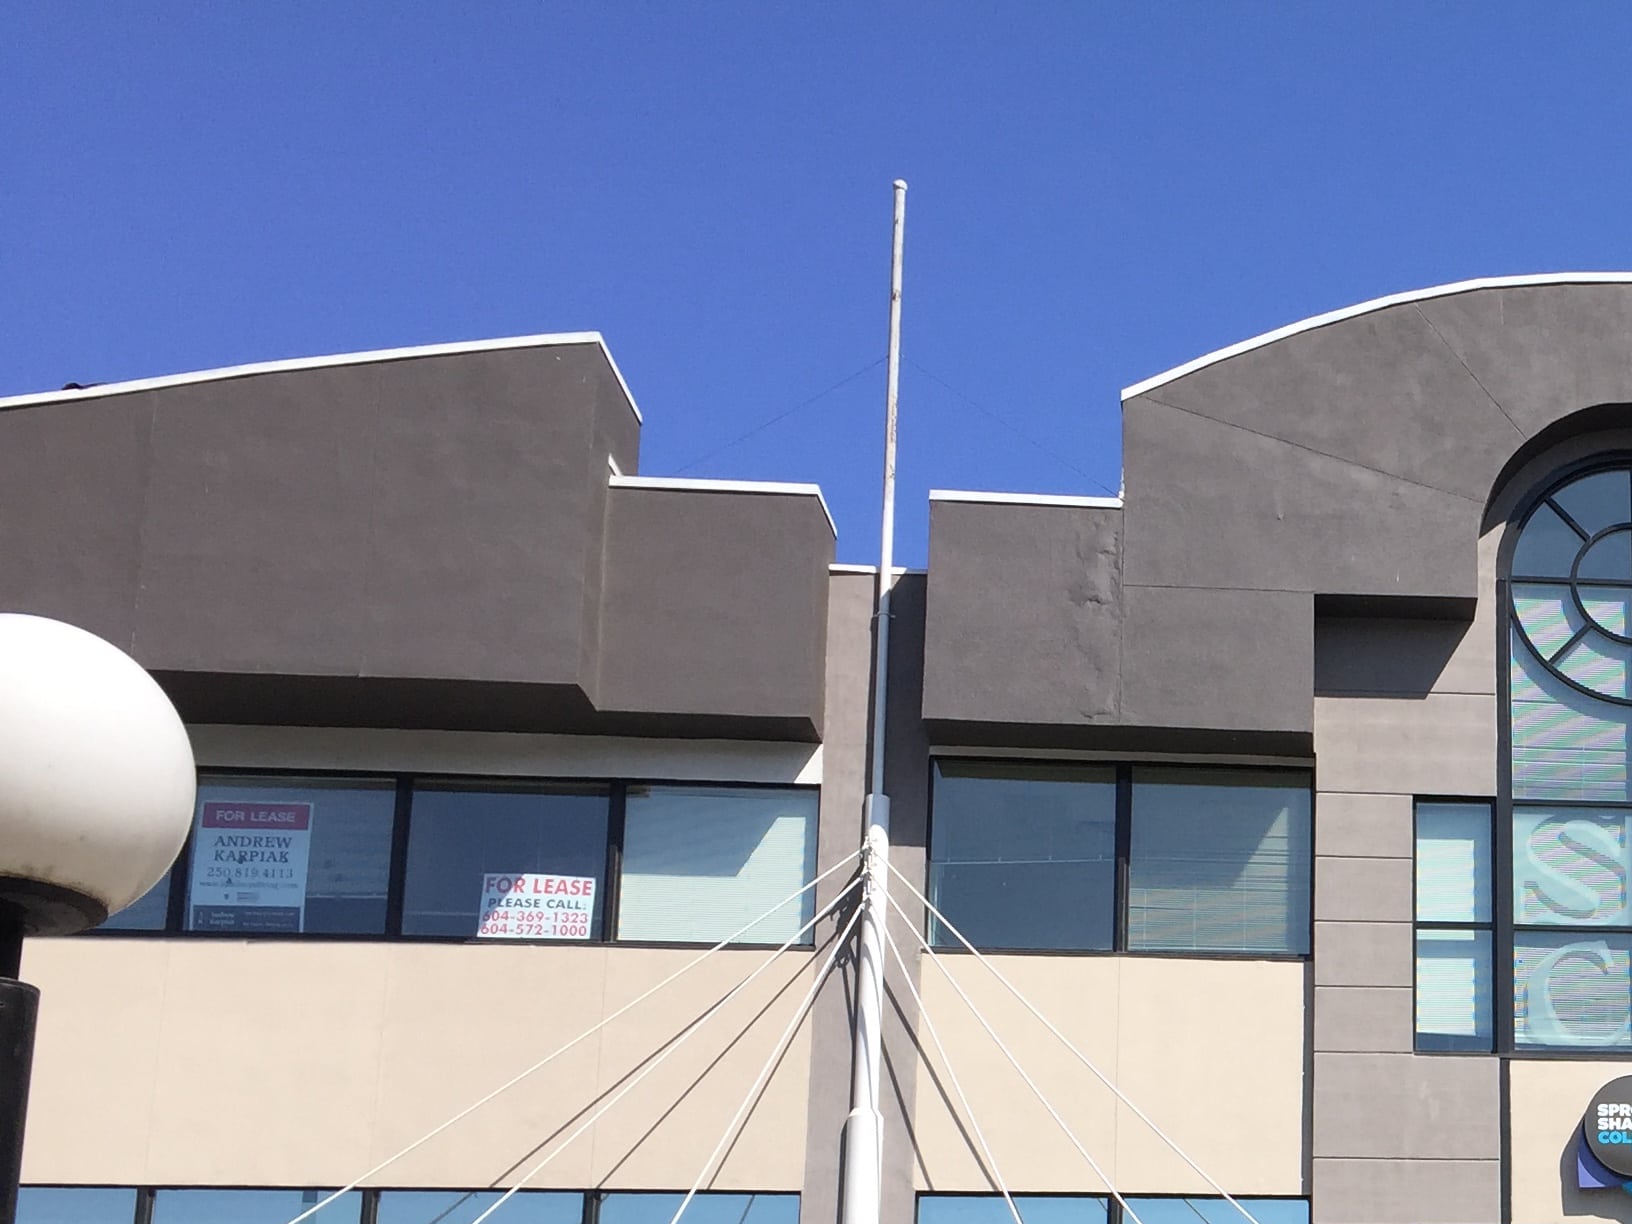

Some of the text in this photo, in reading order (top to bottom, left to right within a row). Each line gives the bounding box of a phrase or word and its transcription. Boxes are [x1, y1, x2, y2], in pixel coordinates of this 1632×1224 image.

[215, 810, 297, 822] FOR LEASE
[214, 835, 293, 848] ANDREW
[214, 850, 289, 863] KARPIAK
[485, 876, 593, 896] FOR LEASE
[488, 897, 587, 910] PLEASE CALL:
[482, 911, 588, 923] 604-369-1323
[480, 923, 587, 936] 604-572-1000
